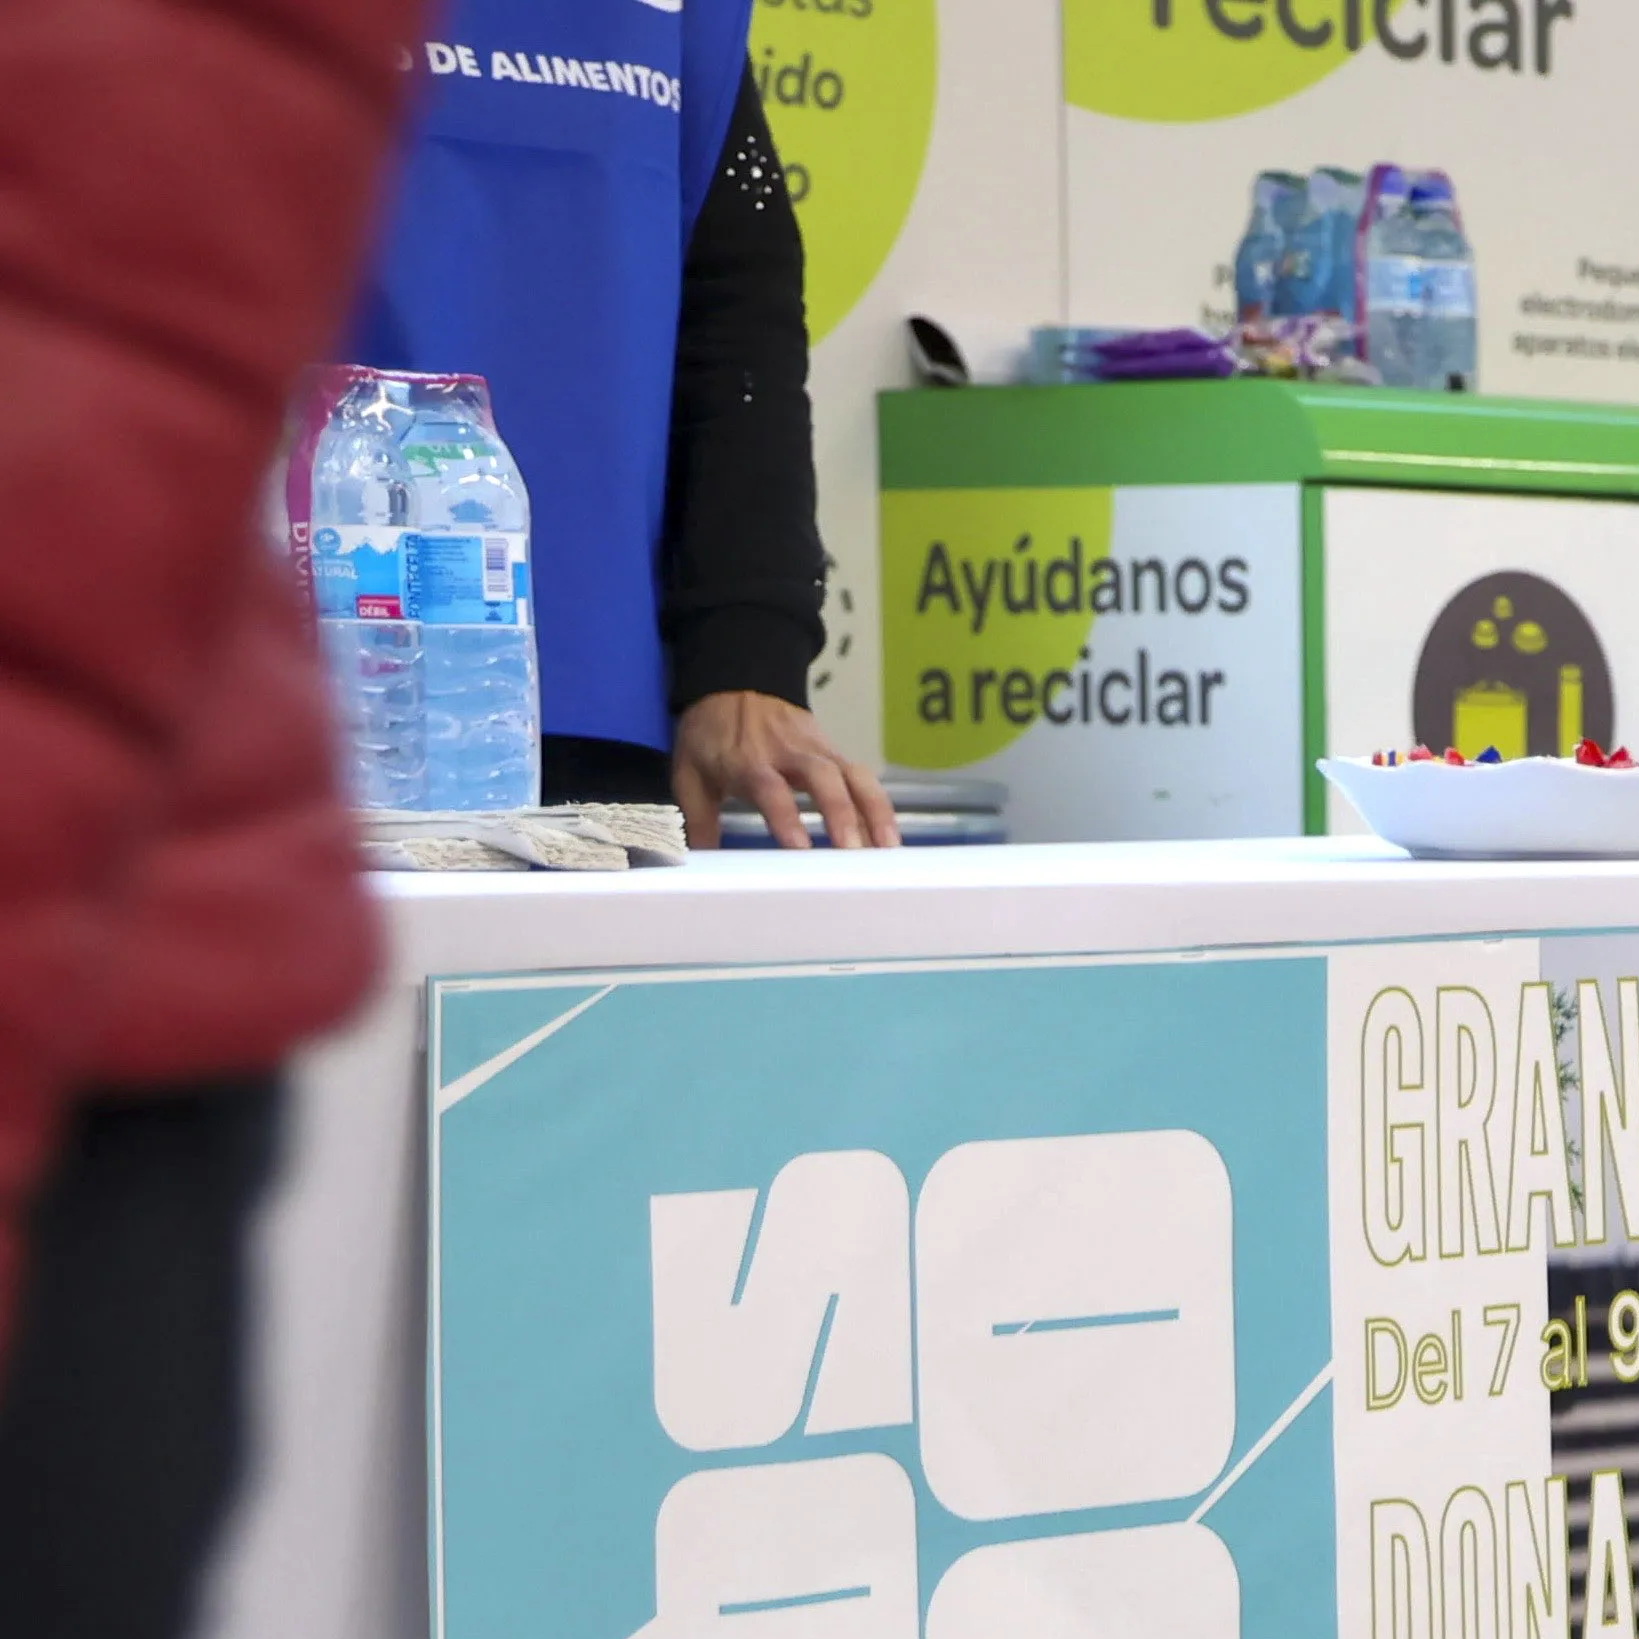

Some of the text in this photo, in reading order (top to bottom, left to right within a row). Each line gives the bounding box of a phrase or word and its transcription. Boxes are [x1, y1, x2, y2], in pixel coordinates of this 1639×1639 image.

[424, 42, 482, 77] DE
[916, 533, 1251, 634] Ayúdanos
[917, 647, 1226, 727] a reciclar
[1365, 1309, 1463, 1412] Del
[1483, 1304, 1521, 1397] 7
[1540, 1296, 1588, 1391] al
